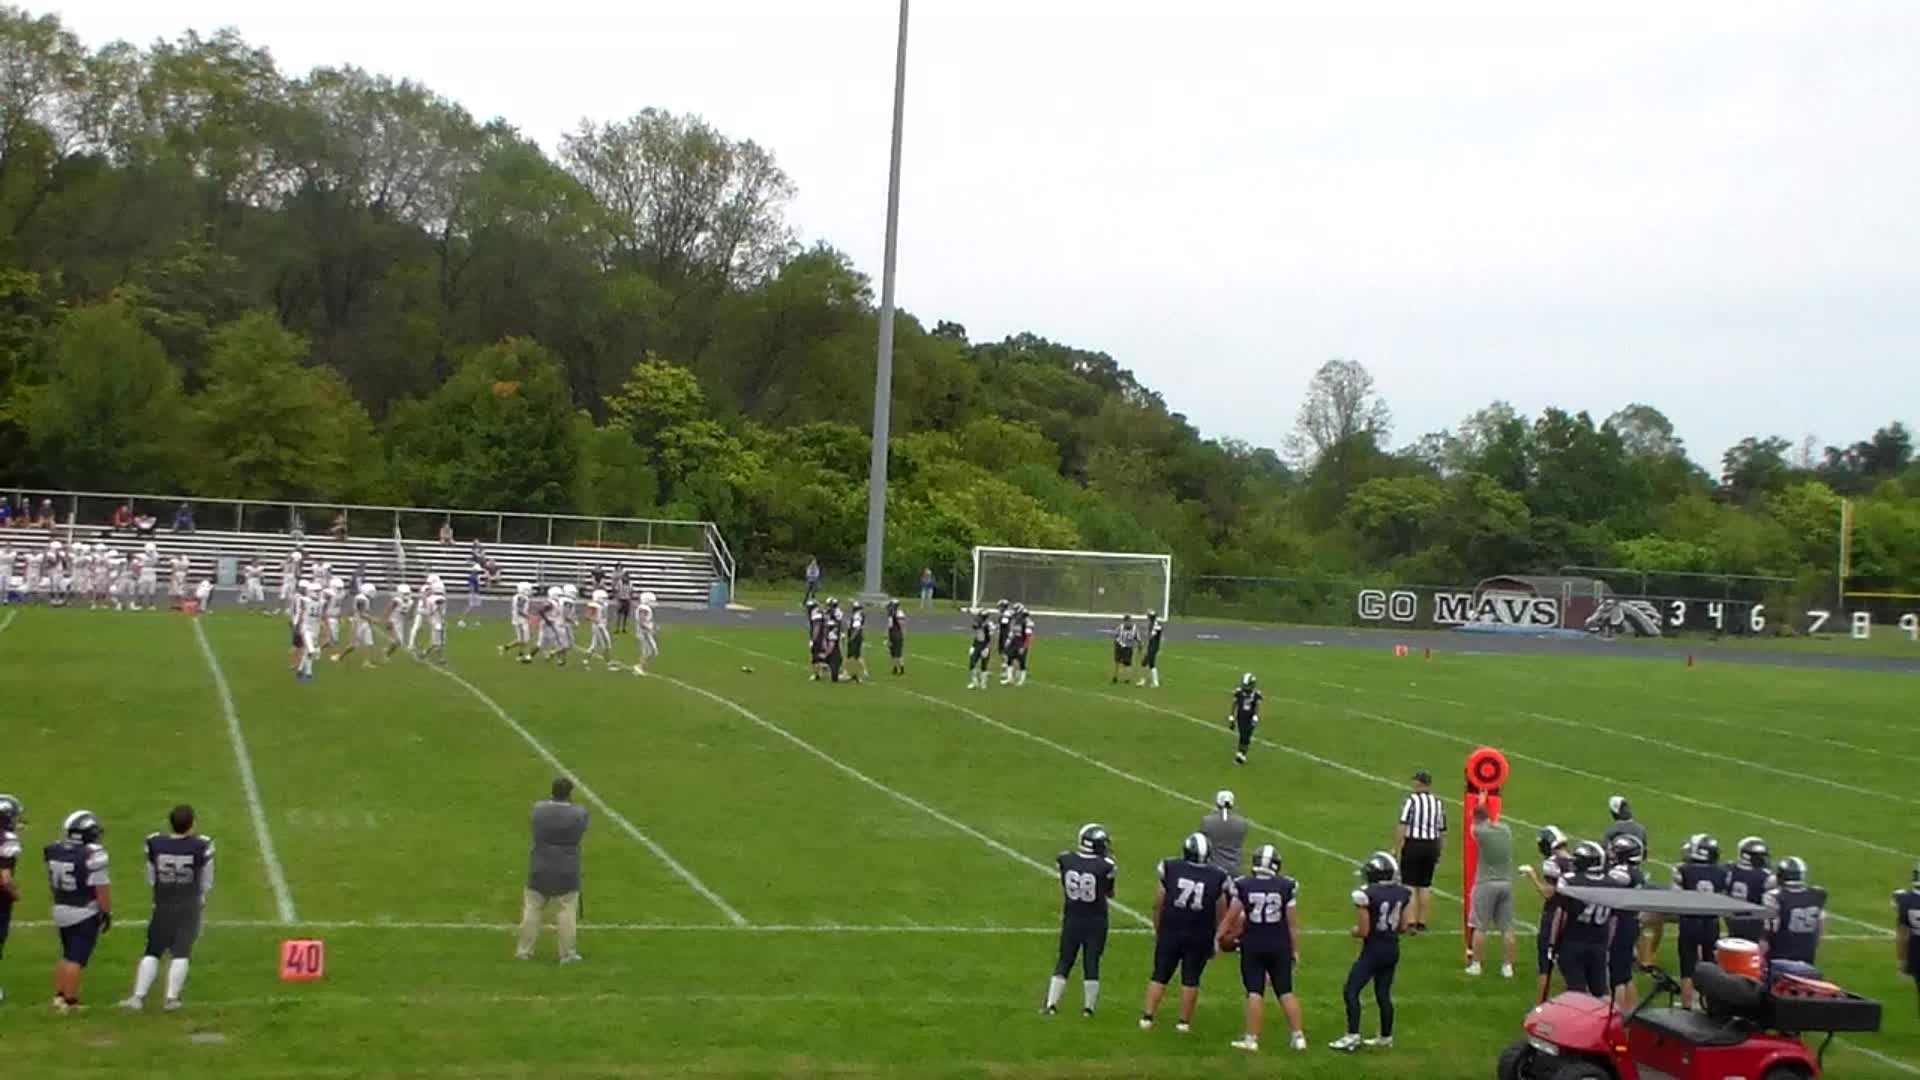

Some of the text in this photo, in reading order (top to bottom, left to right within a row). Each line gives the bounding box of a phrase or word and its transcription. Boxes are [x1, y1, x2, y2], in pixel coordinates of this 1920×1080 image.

[1358, 589, 1559, 627] GO MAVS
[1670, 601, 1919, 640] 3 4 6 7 8 9
[48, 860, 77, 891] 75
[157, 854, 194, 883] 55
[1174, 878, 1205, 911] 71
[1248, 892, 1282, 923] 72
[287, 943, 320, 974] 40
